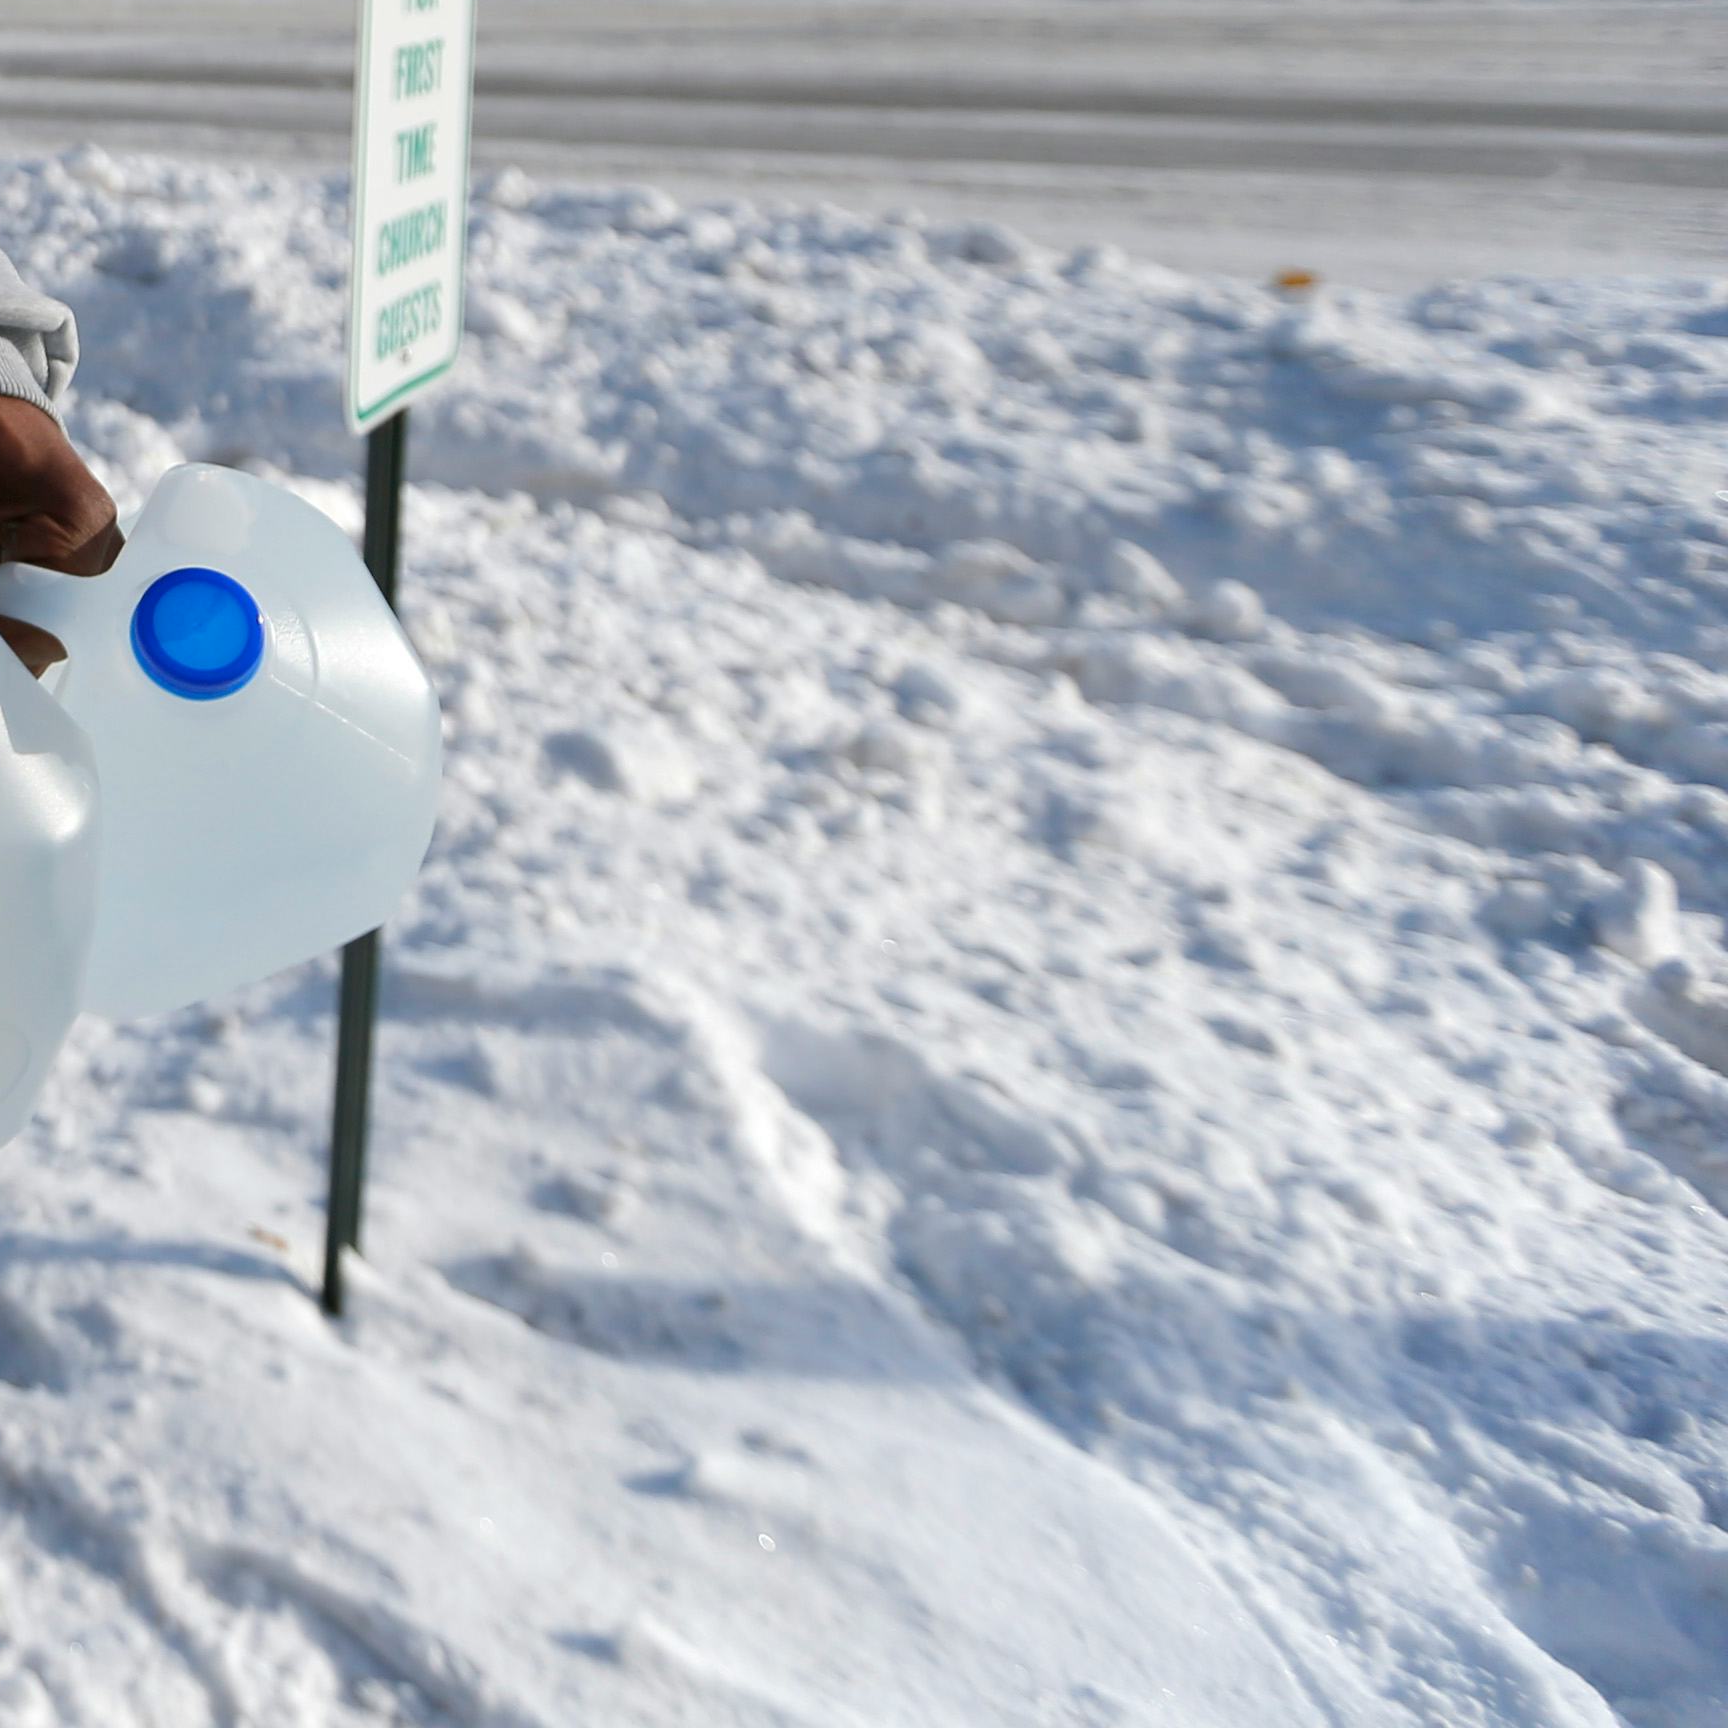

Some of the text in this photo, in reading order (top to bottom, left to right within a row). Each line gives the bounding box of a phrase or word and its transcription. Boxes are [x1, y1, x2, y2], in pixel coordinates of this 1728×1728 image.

[394, 39, 445, 101] FIRST
[397, 122, 438, 184] TIME
[376, 198, 447, 277] CHURCH
[375, 278, 443, 361] GUESTS
